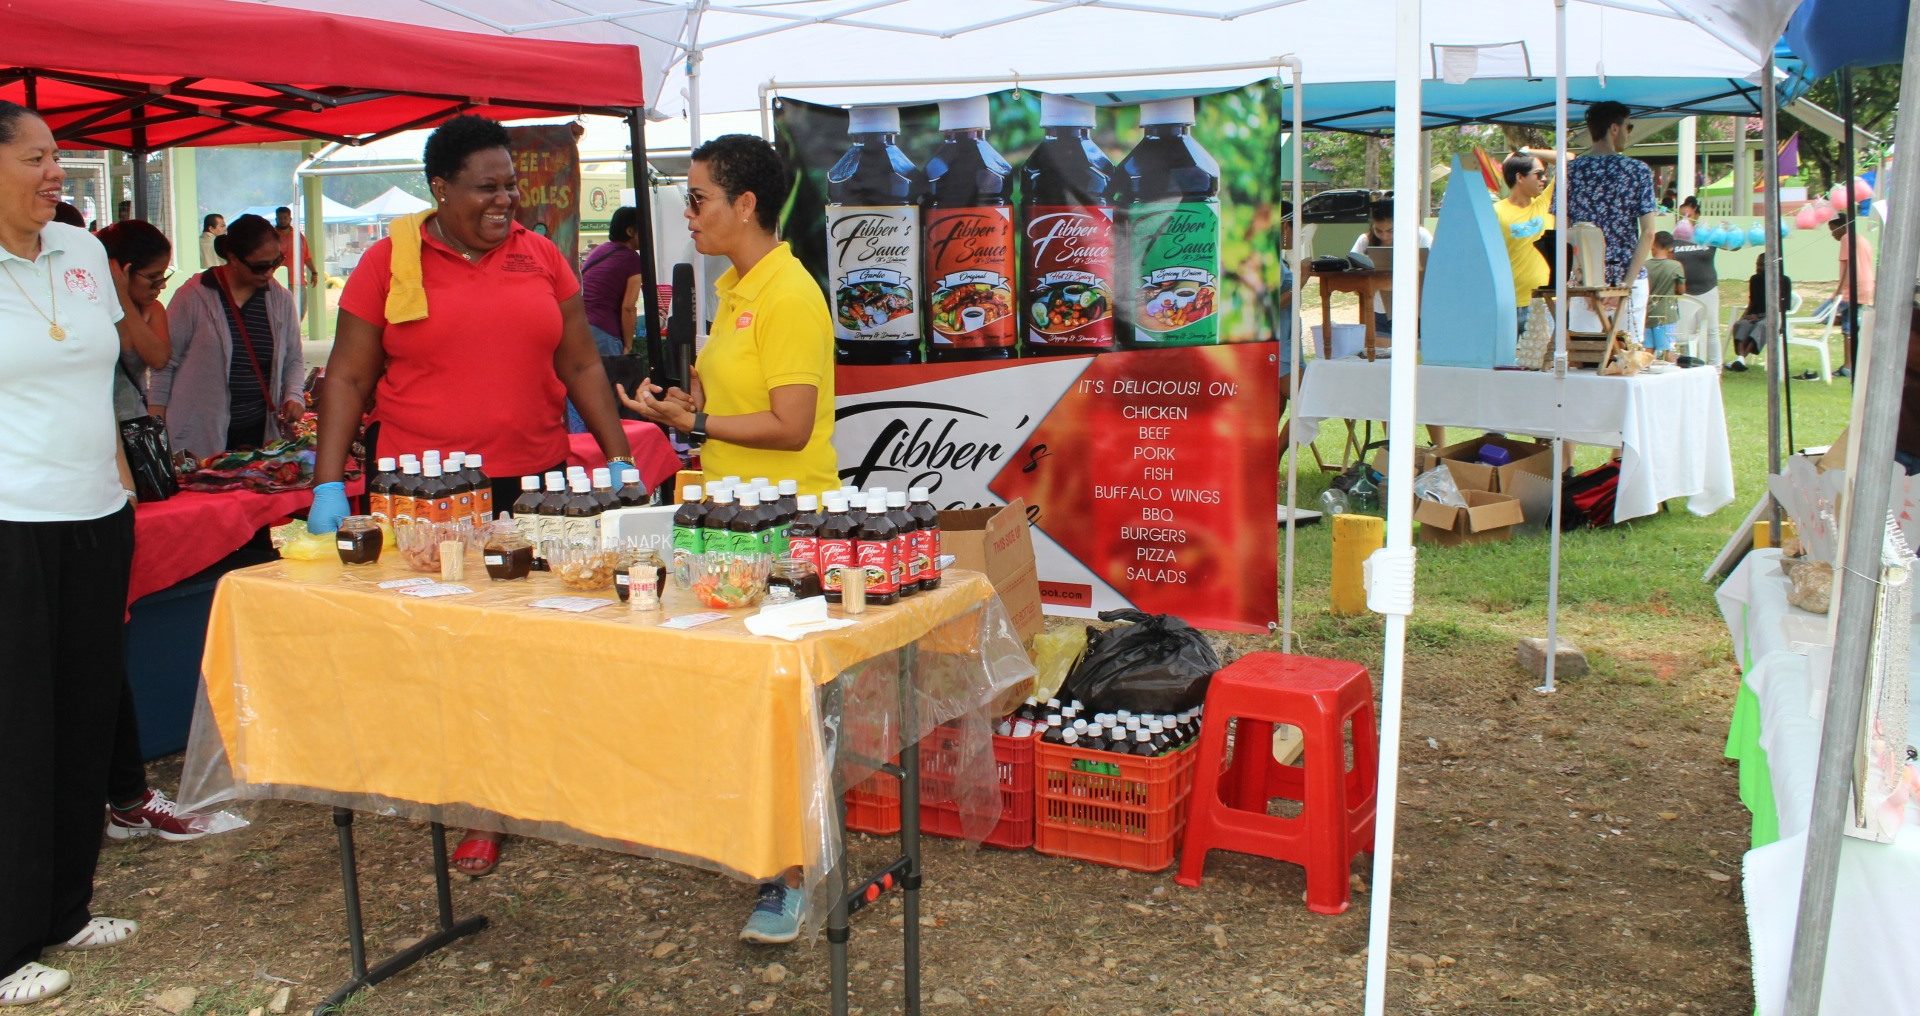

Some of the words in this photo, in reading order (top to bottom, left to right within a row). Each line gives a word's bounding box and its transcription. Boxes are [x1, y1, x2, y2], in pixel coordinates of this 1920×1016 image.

[518, 178, 571, 210] SOLES
[858, 237, 909, 261] Sauce
[955, 238, 1006, 263] Sauce
[1055, 237, 1110, 262] Sauce
[1163, 234, 1215, 259] Sauce
[859, 269, 886, 281] Garlic
[959, 271, 986, 282] Original
[1050, 271, 1065, 280] Hot
[1073, 272, 1093, 282] Spicy
[1181, 269, 1202, 277] Onion
[1078, 379, 1104, 394] IT'S
[1113, 380, 1201, 396] DELICIOUS!
[1208, 382, 1239, 397] ON:
[1122, 405, 1188, 420] CHICKEN
[1139, 426, 1171, 440] BEEF
[1133, 446, 1175, 461] PORK
[1144, 467, 1173, 480] FISH
[1095, 485, 1162, 501] BUFFALO
[1171, 488, 1220, 504] WINGS
[1142, 507, 1174, 522] BBQ
[1121, 526, 1187, 543] BURGERS
[1136, 547, 1177, 562] PIZZA
[1126, 567, 1187, 584] SALADS
